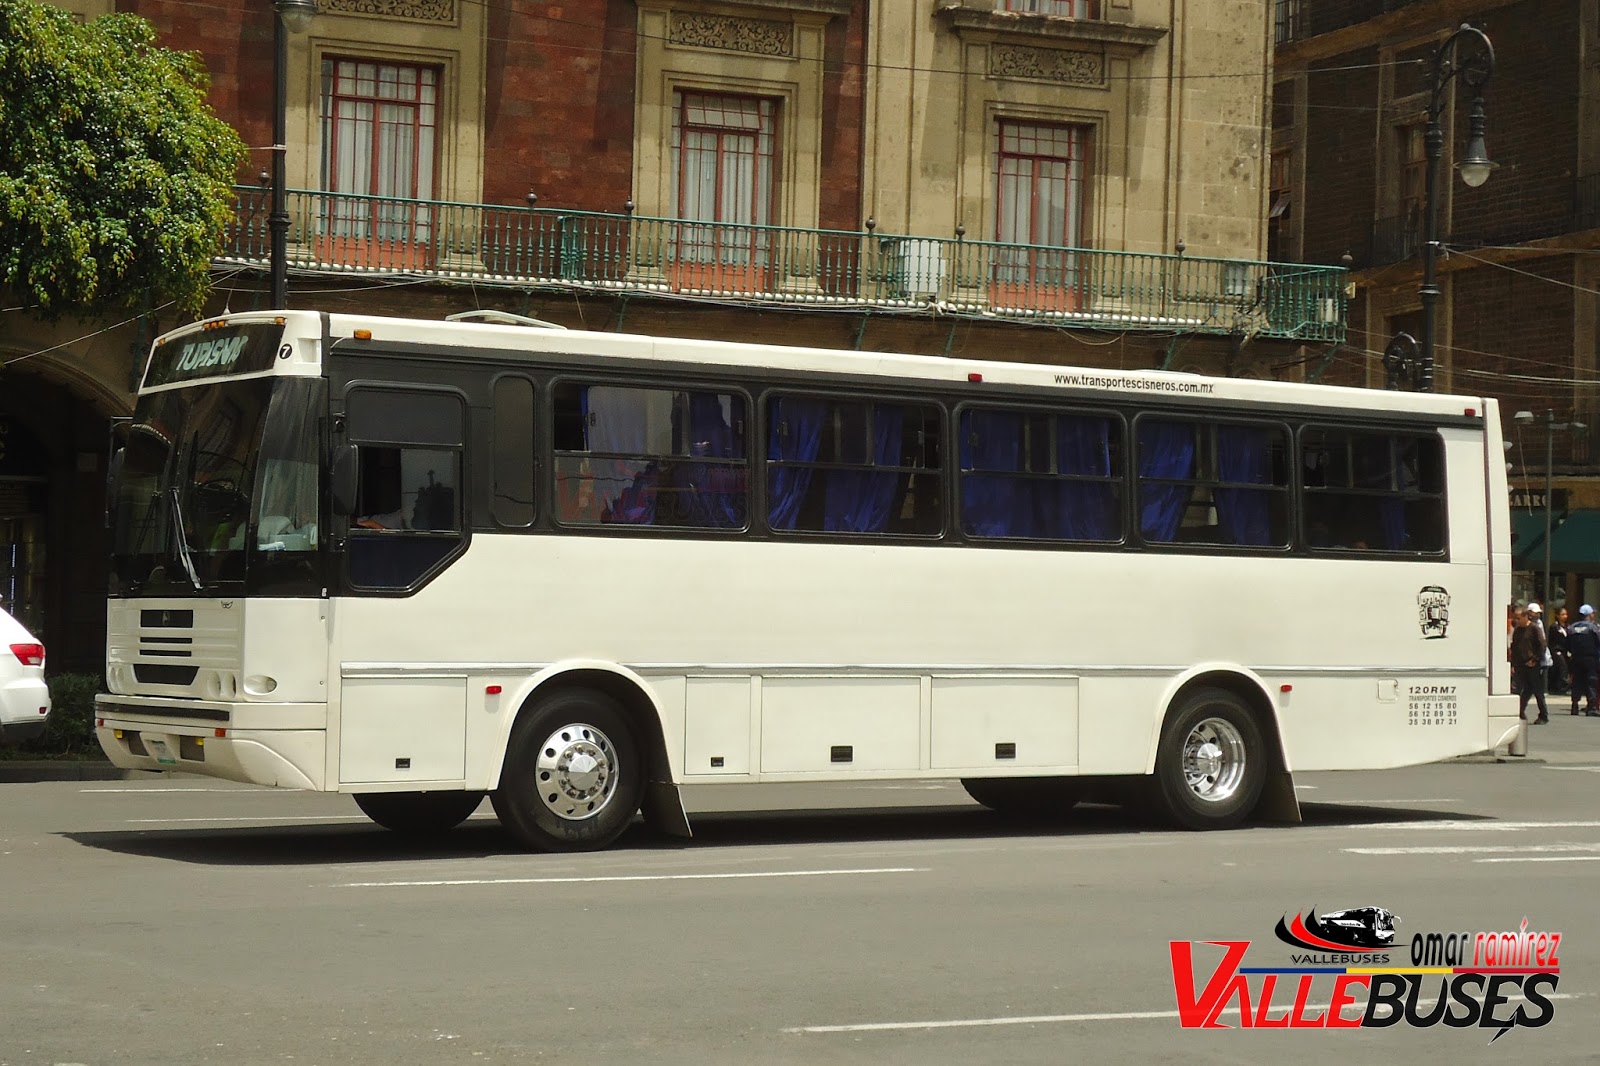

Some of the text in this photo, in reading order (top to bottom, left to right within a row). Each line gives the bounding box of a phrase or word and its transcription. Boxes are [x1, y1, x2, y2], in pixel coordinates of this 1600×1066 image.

[281, 346, 291, 358] 7
[1054, 374, 1214, 394] www.transportescisneros.com.mx
[1409, 686, 1456, 694] 120RM7
[1409, 702, 1419, 710] 56
[1422, 702, 1431, 710] 12
[1435, 702, 1443, 710] 15
